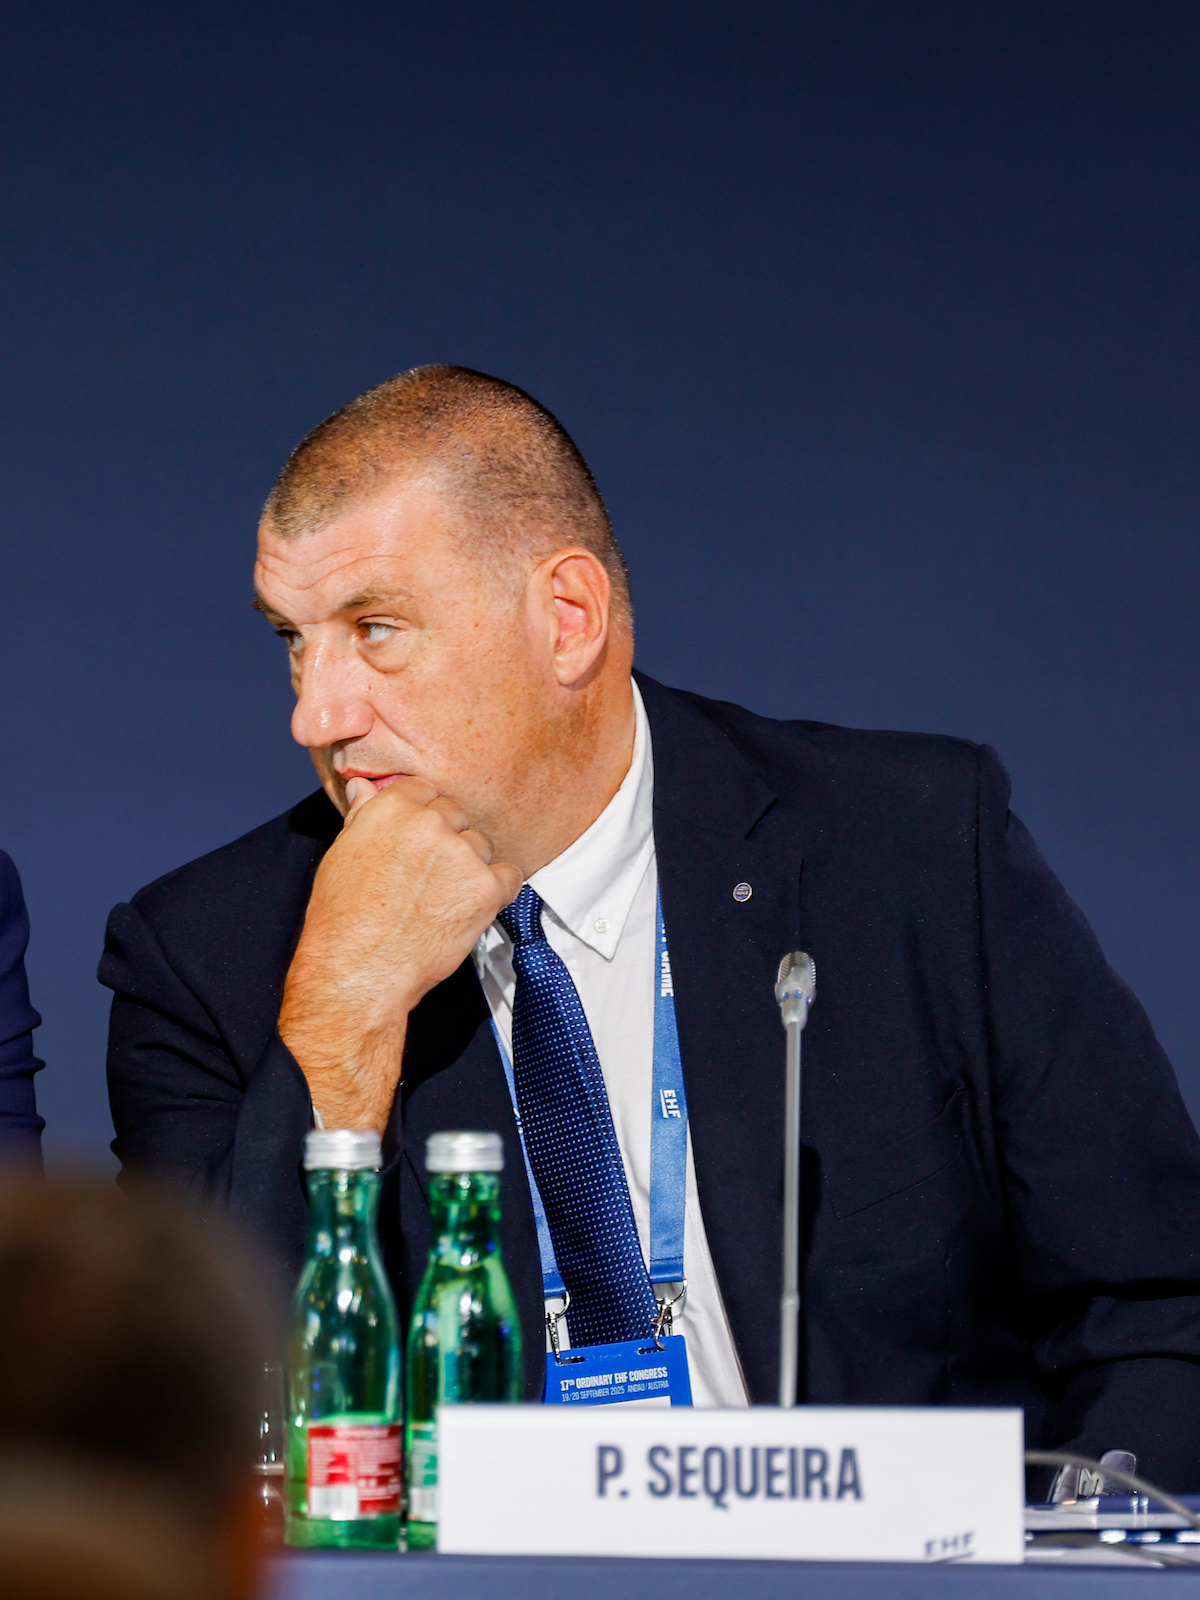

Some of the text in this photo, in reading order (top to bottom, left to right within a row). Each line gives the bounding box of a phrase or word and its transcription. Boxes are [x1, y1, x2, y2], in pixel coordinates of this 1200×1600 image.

[661, 1088, 681, 1118] EHF
[576, 1374, 613, 1389] ORDINARY
[614, 1372, 628, 1383] EHF
[629, 1367, 668, 1381] CONGRESS
[581, 1388, 610, 1399] SEPTEMBER
[611, 1385, 626, 1396] 2025
[596, 1444, 864, 1511] P. SEQUEIRA
[924, 1532, 976, 1559] EHF
